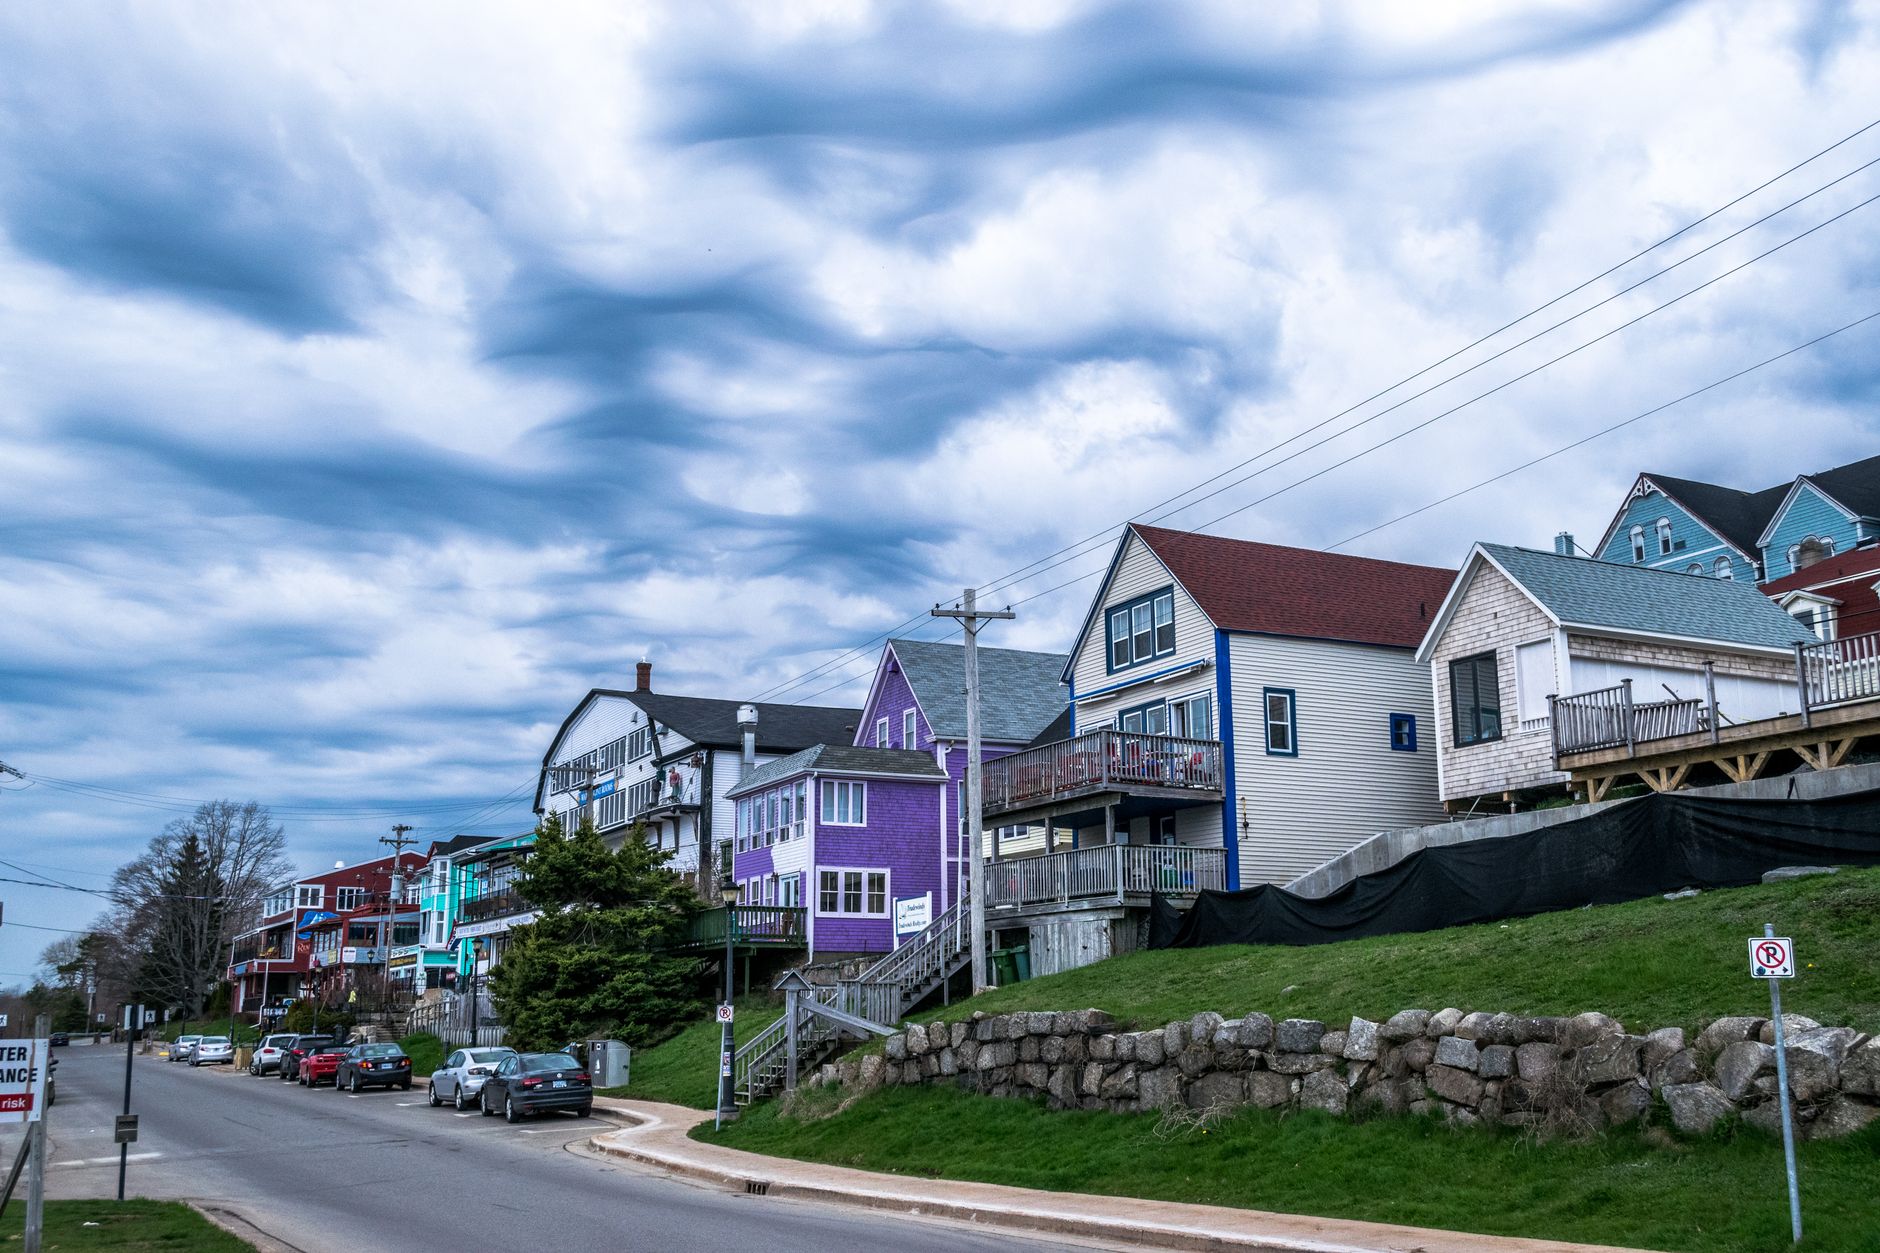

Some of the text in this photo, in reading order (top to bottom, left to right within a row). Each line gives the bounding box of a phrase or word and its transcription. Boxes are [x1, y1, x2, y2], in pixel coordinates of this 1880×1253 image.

[1766, 946, 1777, 964] P
[0, 1047, 27, 1061] TER
[2, 1097, 26, 1109] risk
